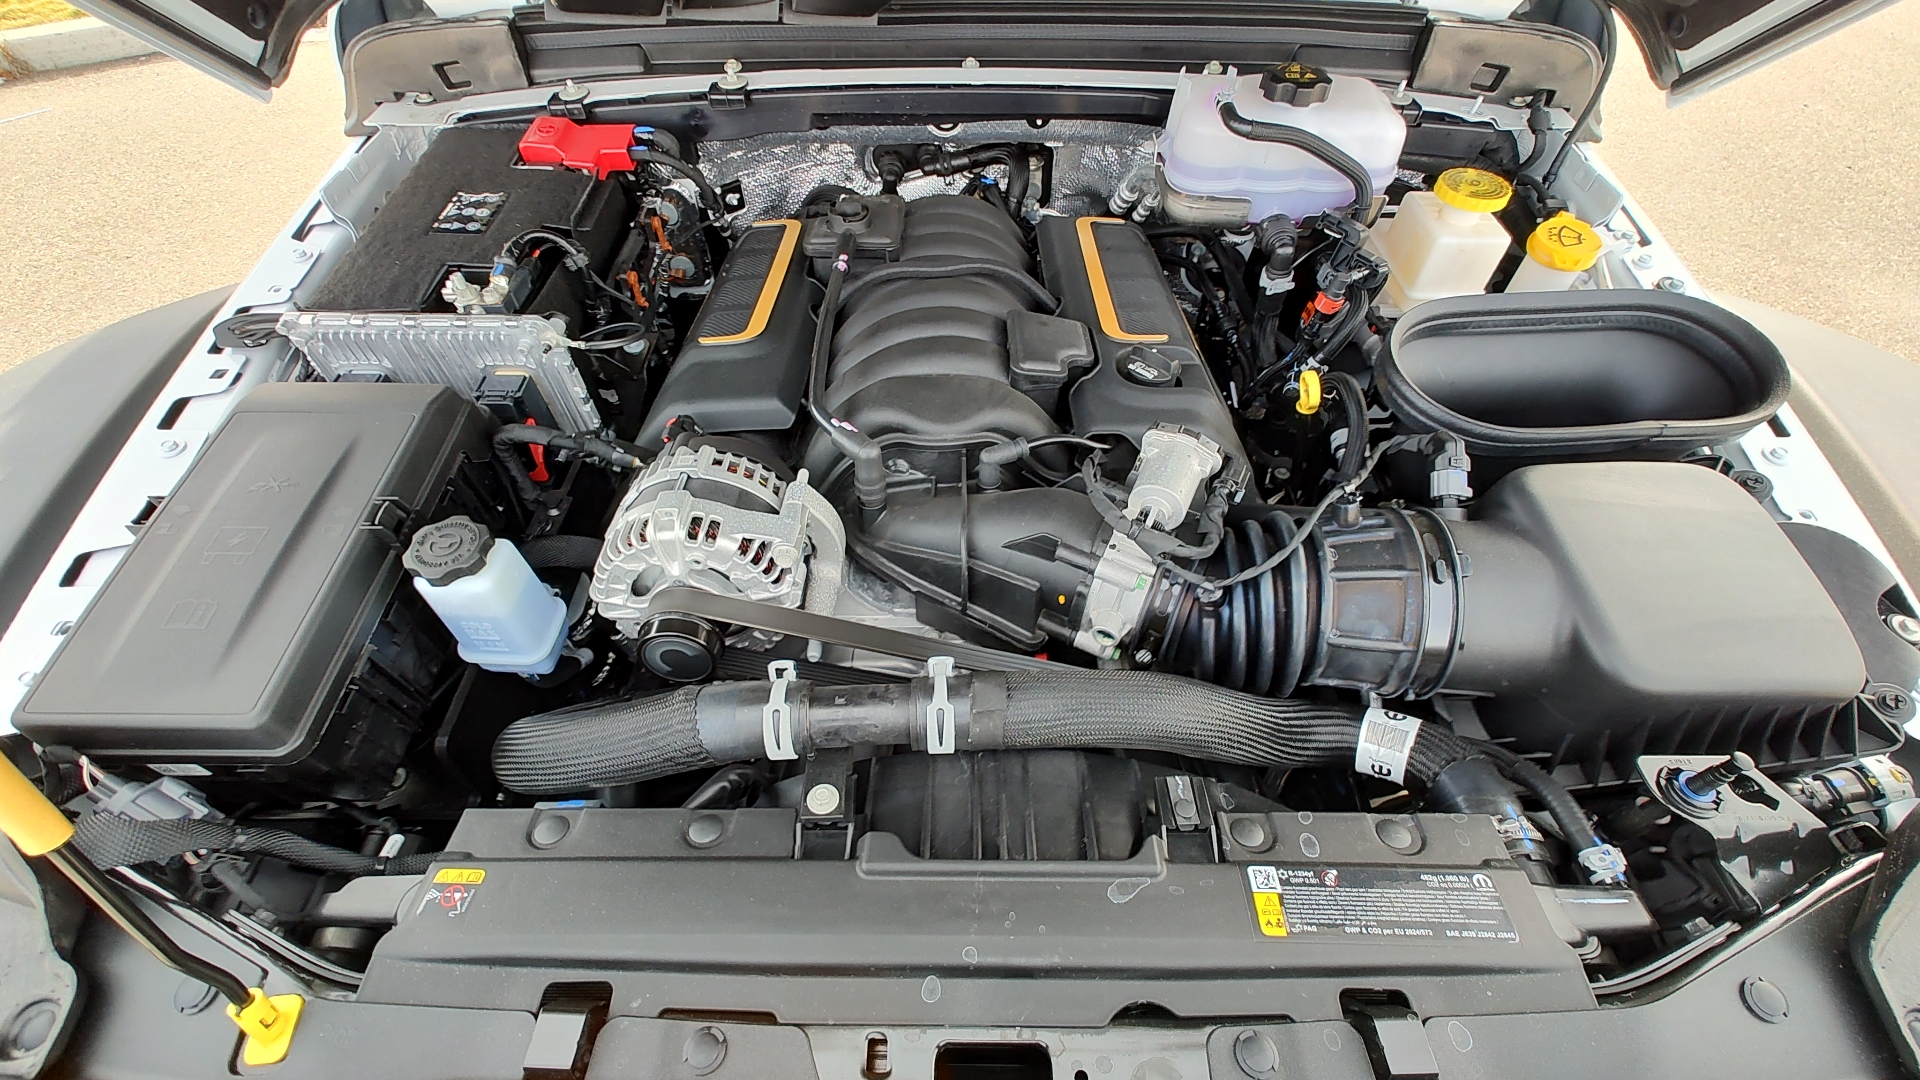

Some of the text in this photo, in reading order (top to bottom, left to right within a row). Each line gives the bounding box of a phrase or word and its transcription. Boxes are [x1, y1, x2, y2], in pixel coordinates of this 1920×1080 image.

[1303, 925, 1317, 933] PAG
[1345, 926, 1360, 934] GWP
[1368, 927, 1382, 935] CO2
